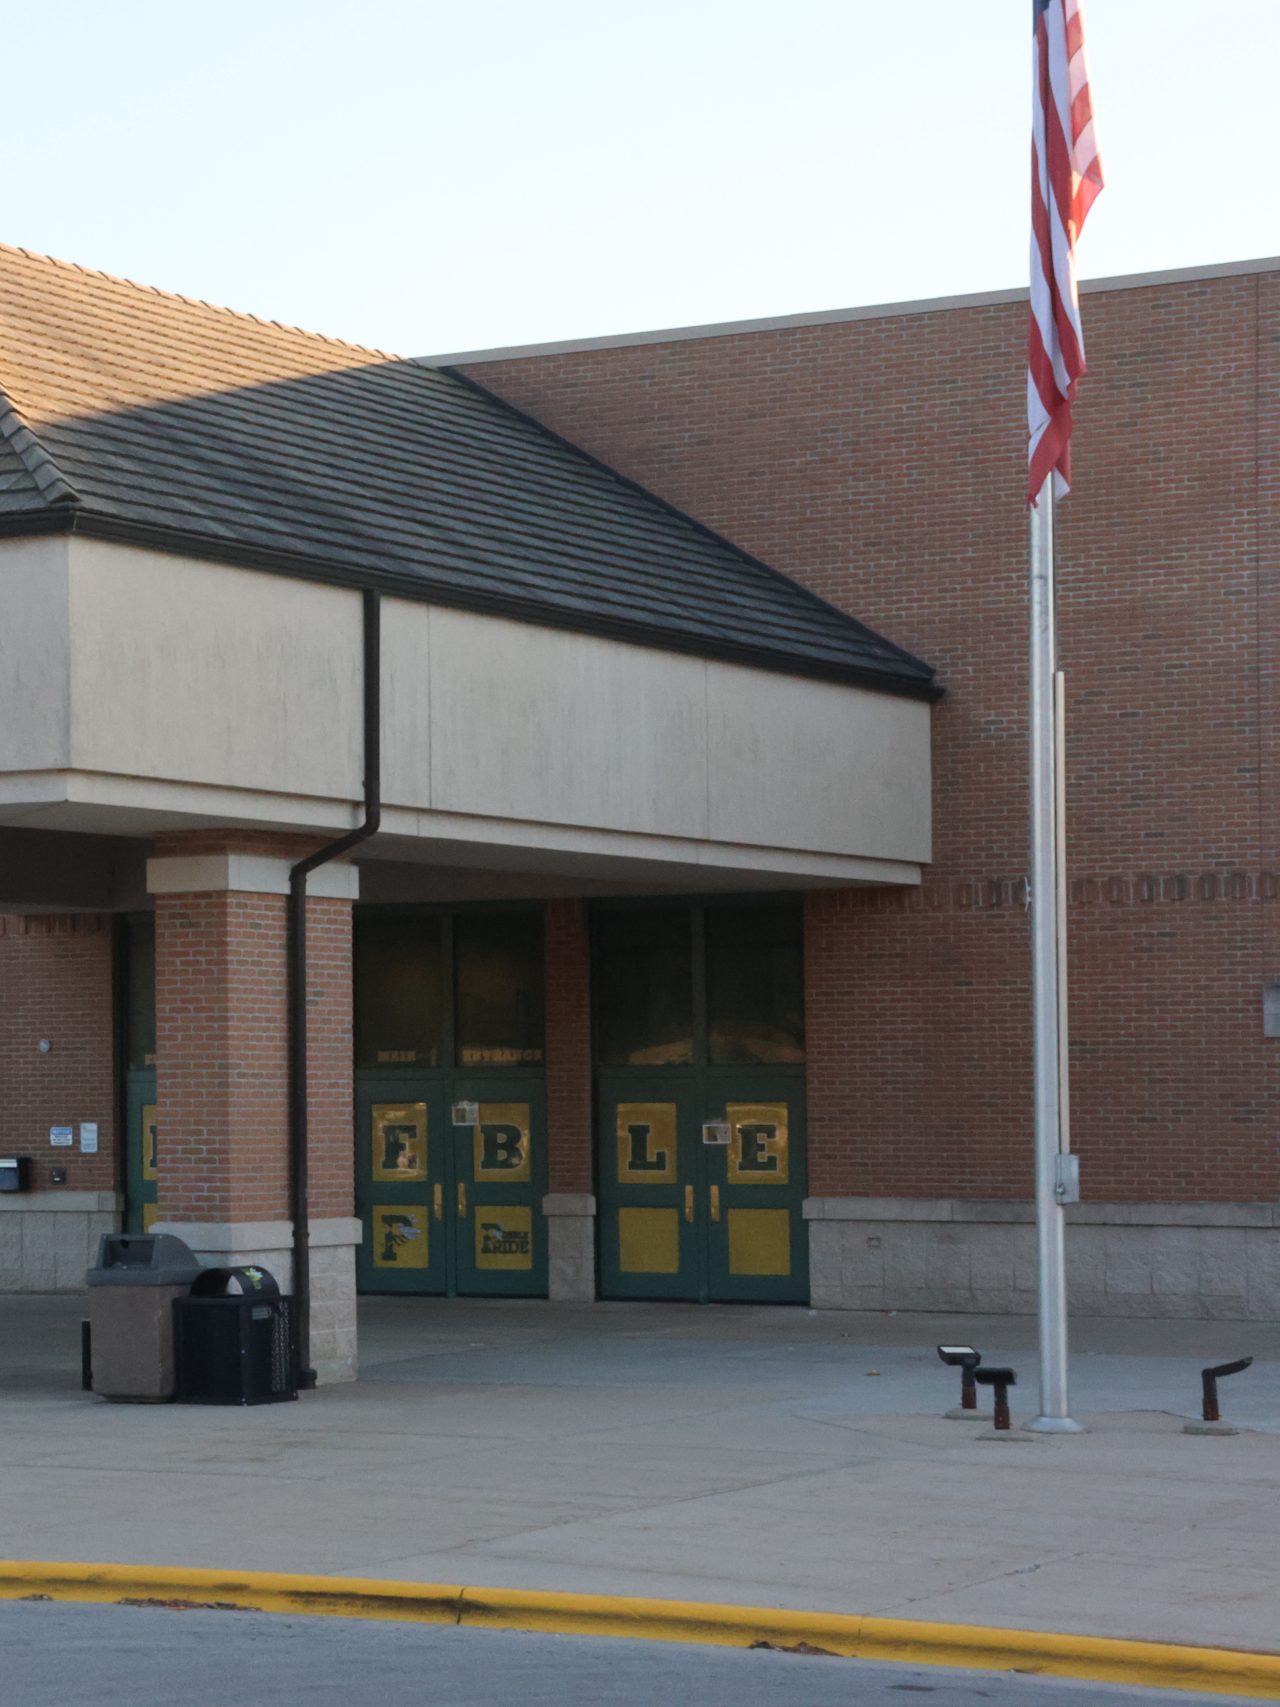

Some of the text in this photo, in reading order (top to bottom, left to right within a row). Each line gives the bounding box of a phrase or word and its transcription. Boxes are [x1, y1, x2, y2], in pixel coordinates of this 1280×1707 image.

[479, 1124, 524, 1170] B
[627, 1123, 667, 1171] L
[737, 1123, 778, 1172] E
